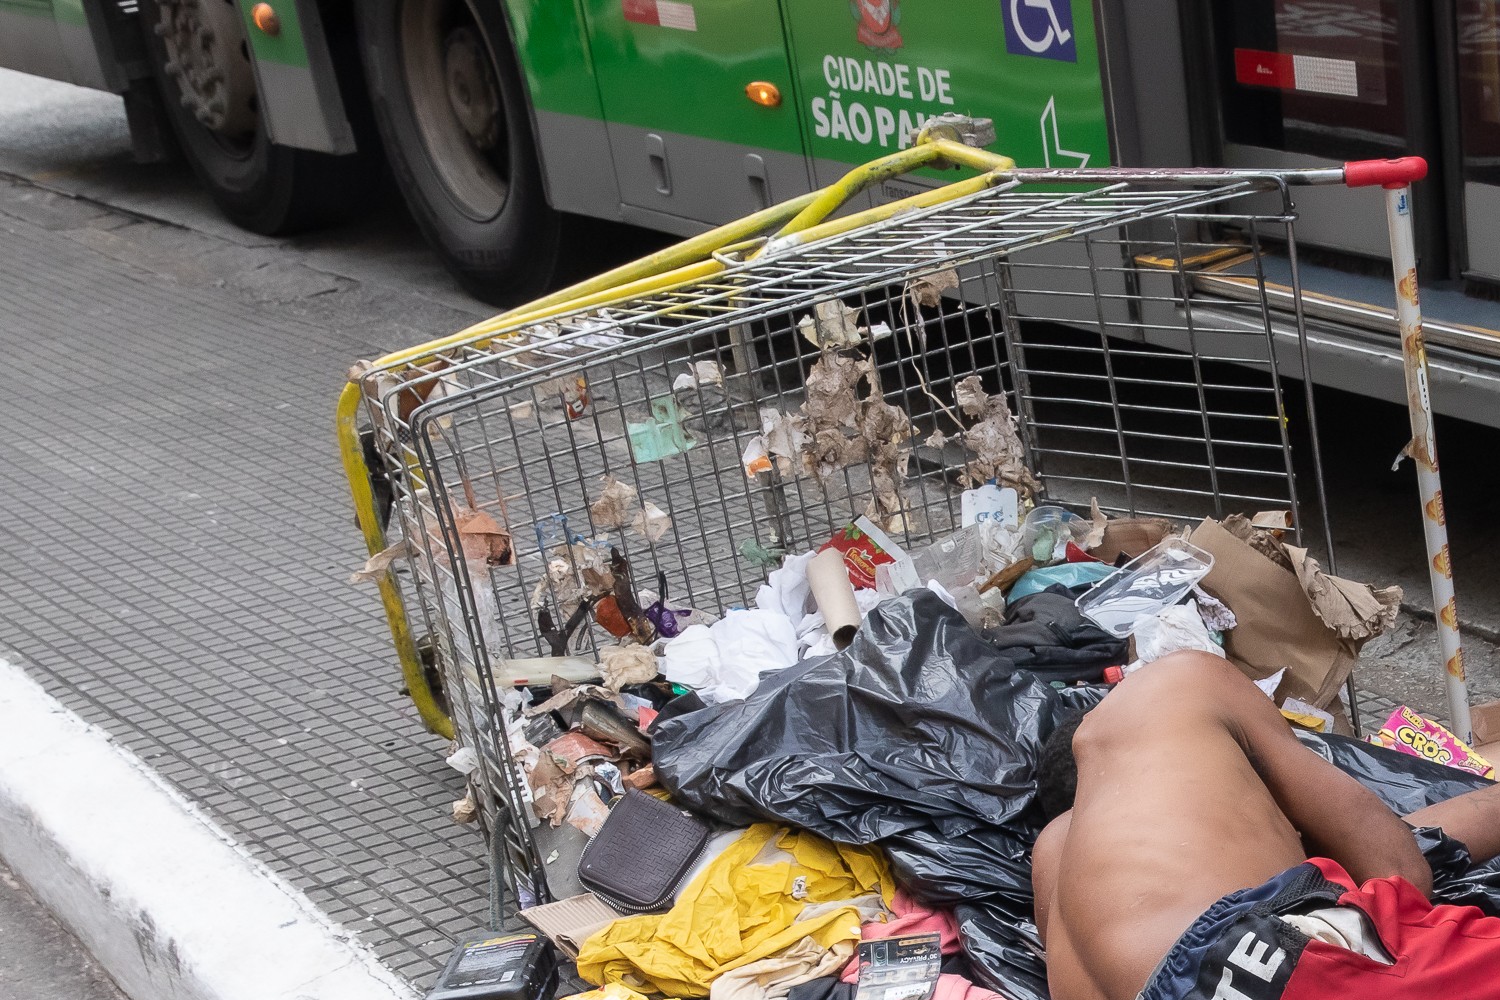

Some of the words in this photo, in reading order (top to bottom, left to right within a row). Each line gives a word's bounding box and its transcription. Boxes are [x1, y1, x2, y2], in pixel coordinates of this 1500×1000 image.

[823, 54, 914, 99] CIDADE
[917, 66, 954, 105] DE
[811, 90, 873, 145] SÃO
